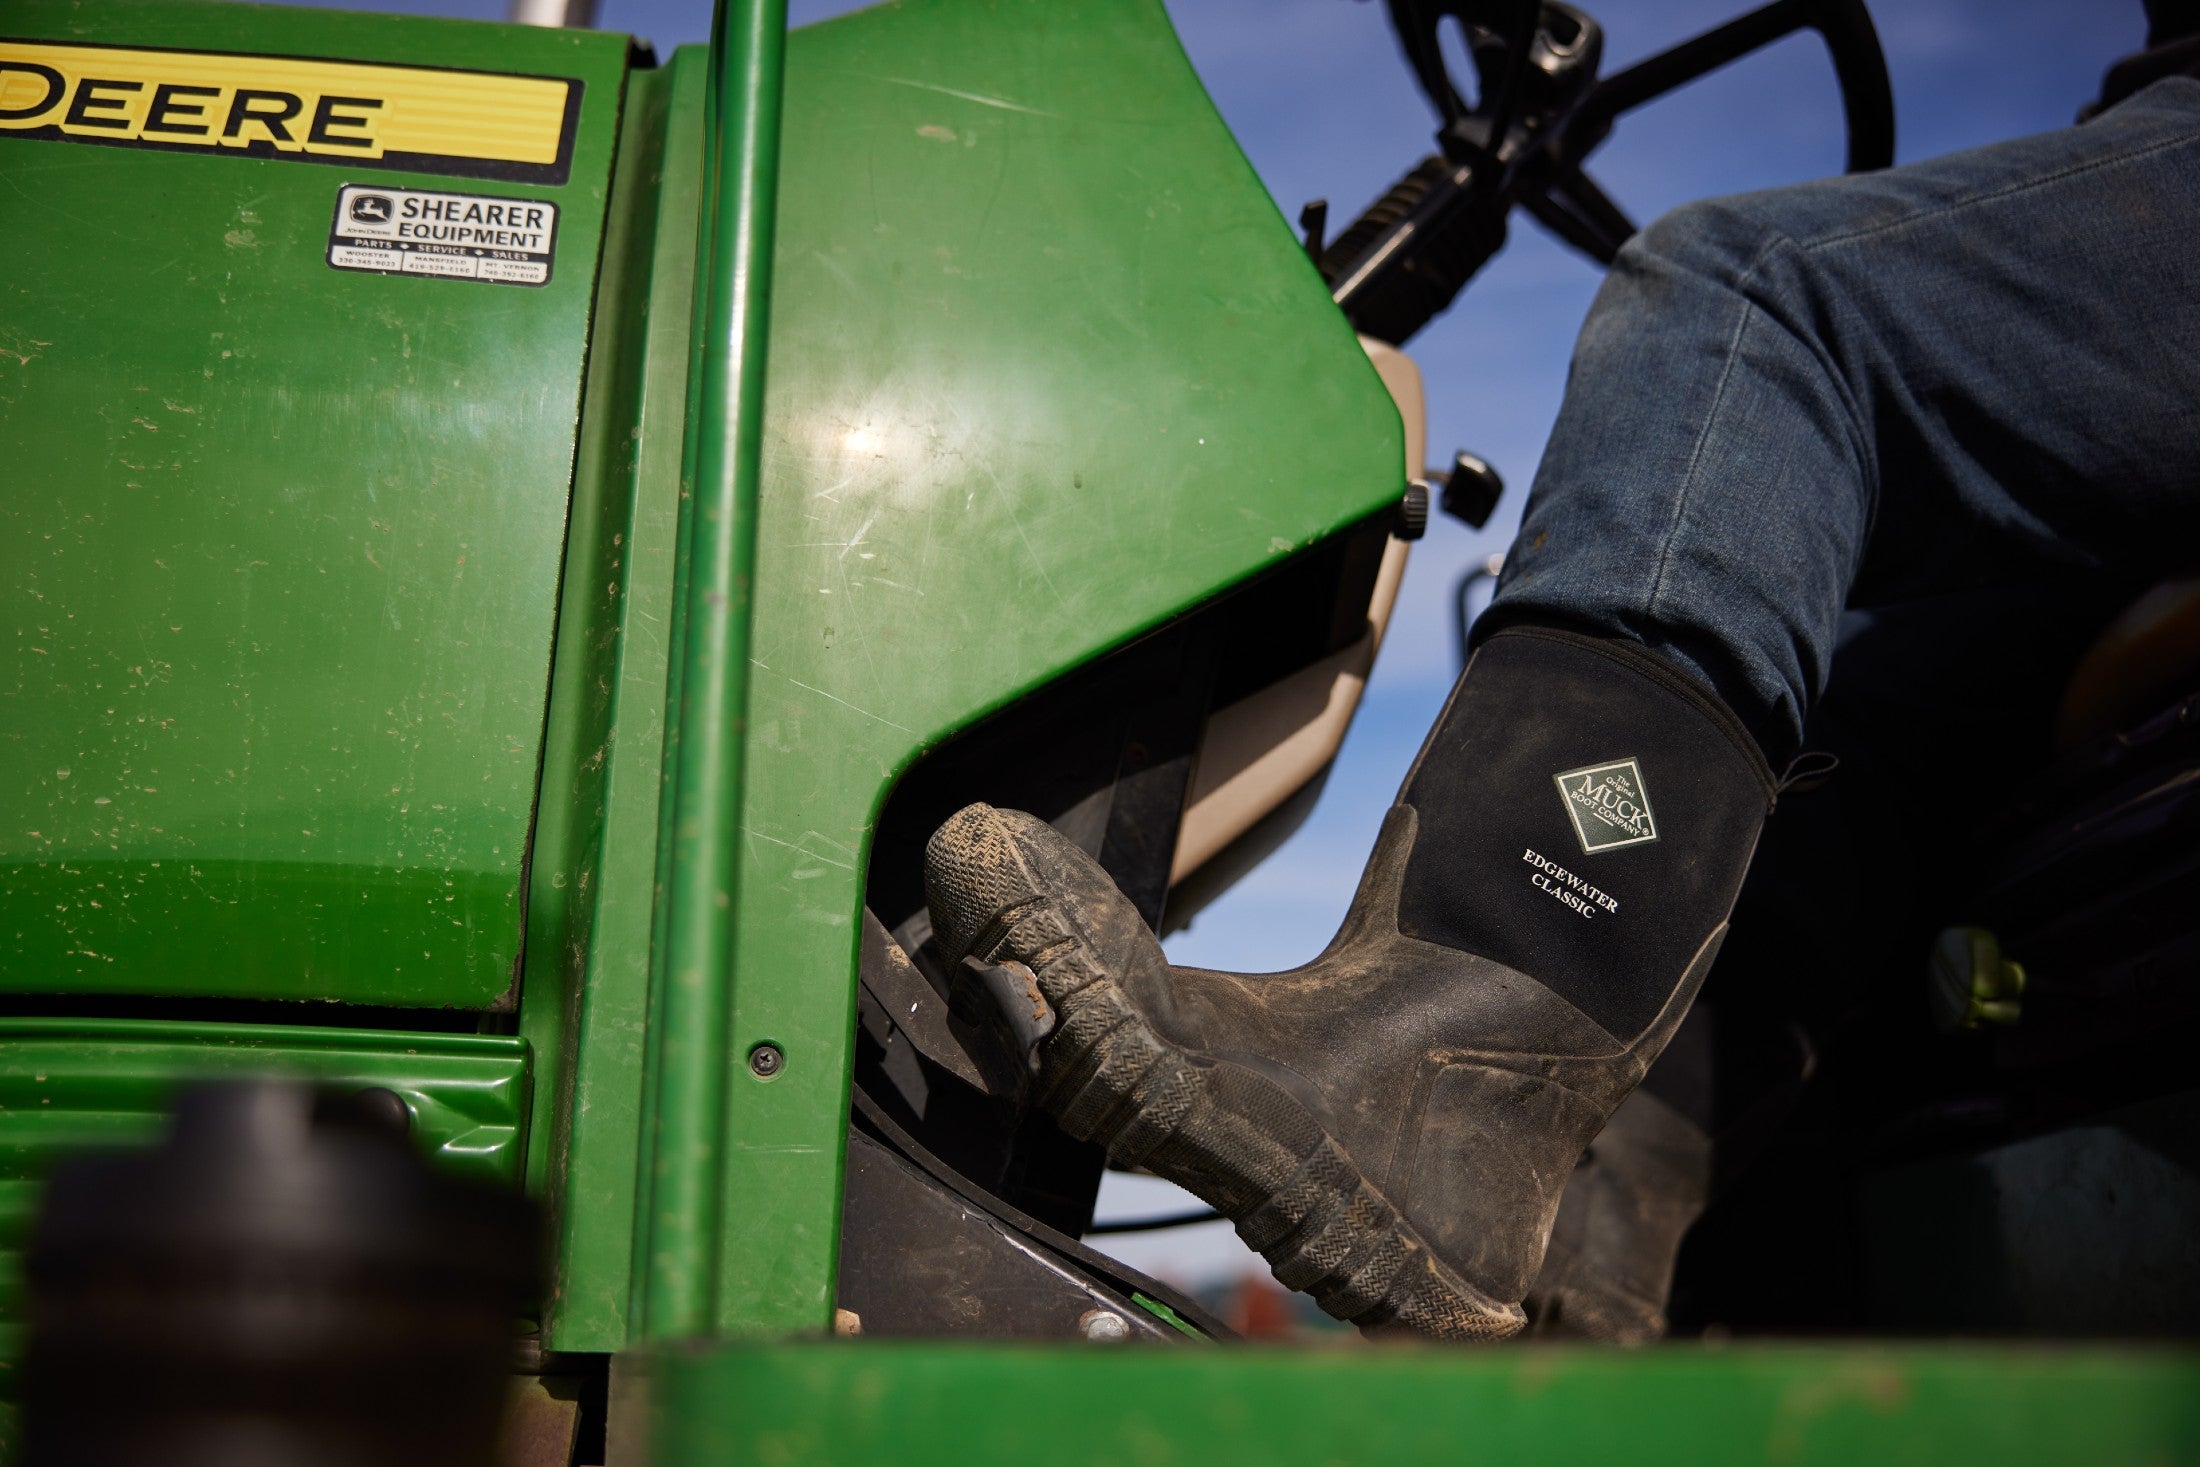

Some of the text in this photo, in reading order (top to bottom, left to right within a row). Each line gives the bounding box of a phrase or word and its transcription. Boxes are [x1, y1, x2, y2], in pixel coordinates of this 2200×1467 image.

[0, 61, 384, 148] DEERE
[401, 197, 543, 230] SHEARER
[398, 222, 543, 248] EQUIPMENT
[346, 250, 390, 258] WOOSTER
[354, 239, 529, 261] PARTS SERVICE SALES
[415, 256, 467, 265] MANSFIELD
[1606, 776, 1635, 798] Original
[1616, 775, 1630, 787] The
[1570, 790, 1641, 837] BOOT COMPANY
[1578, 775, 1648, 829] MUCK
[1522, 848, 1619, 914] EDGEWATER
[1531, 872, 1596, 919] CLASSIC
